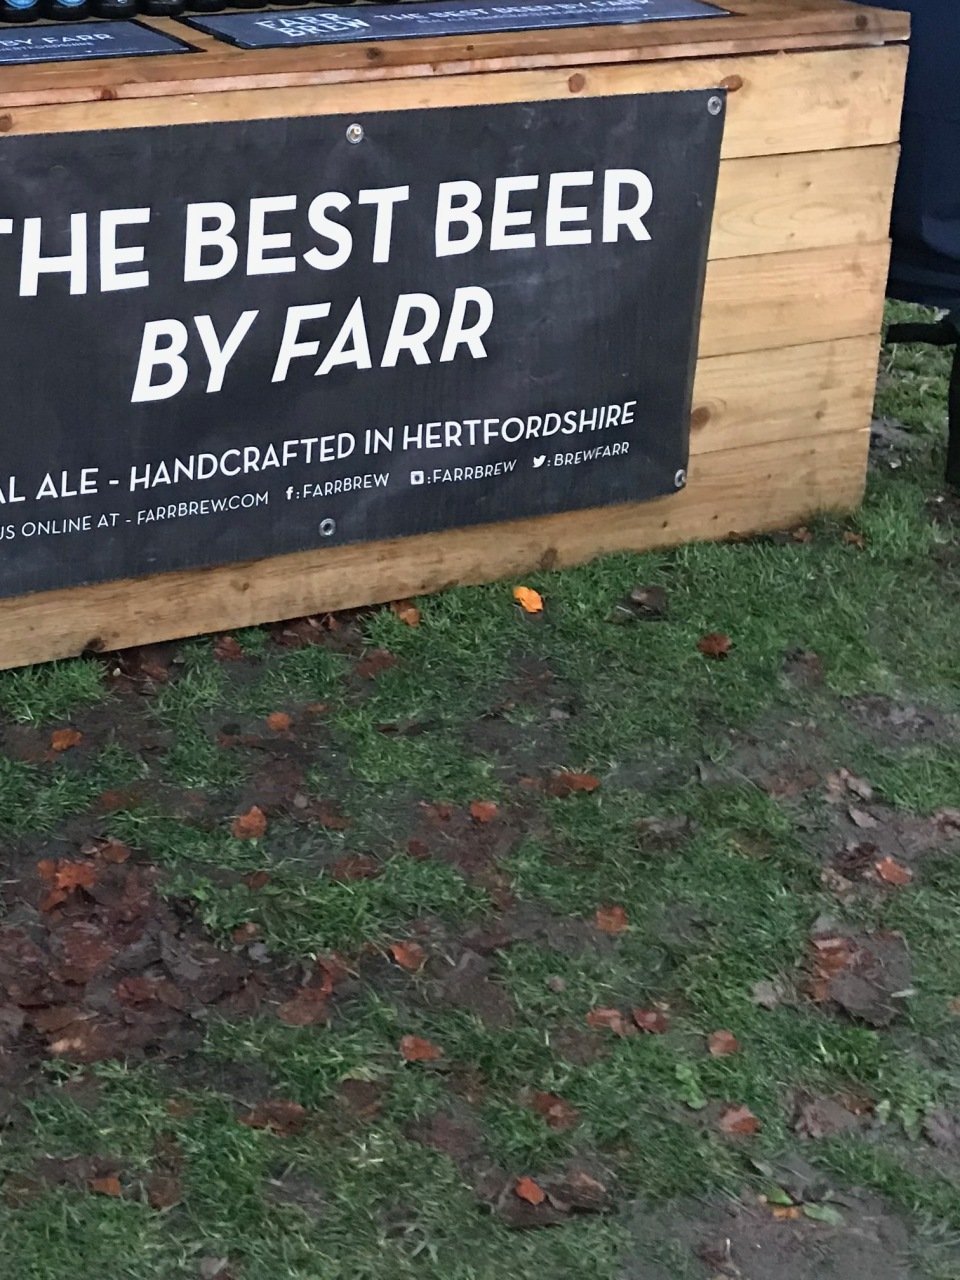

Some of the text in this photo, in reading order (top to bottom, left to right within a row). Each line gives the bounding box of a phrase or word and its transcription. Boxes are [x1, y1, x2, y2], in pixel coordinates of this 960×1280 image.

[42, 33, 115, 43] FARR
[254, 12, 351, 30] FARR
[275, 18, 371, 38] BREW
[184, 185, 409, 282] BEST
[434, 168, 653, 258] BEER
[130, 286, 494, 403] BY FARR
[36, 467, 99, 500] ALE
[129, 432, 356, 492] HANDCRAFTED
[364, 426, 393, 455] IN
[402, 400, 638, 450] HERTFORDSHIRE
[21, 516, 92, 538] ONLINE
[97, 513, 120, 528] AT
[137, 492, 269, 525] FARRBREW.COM
